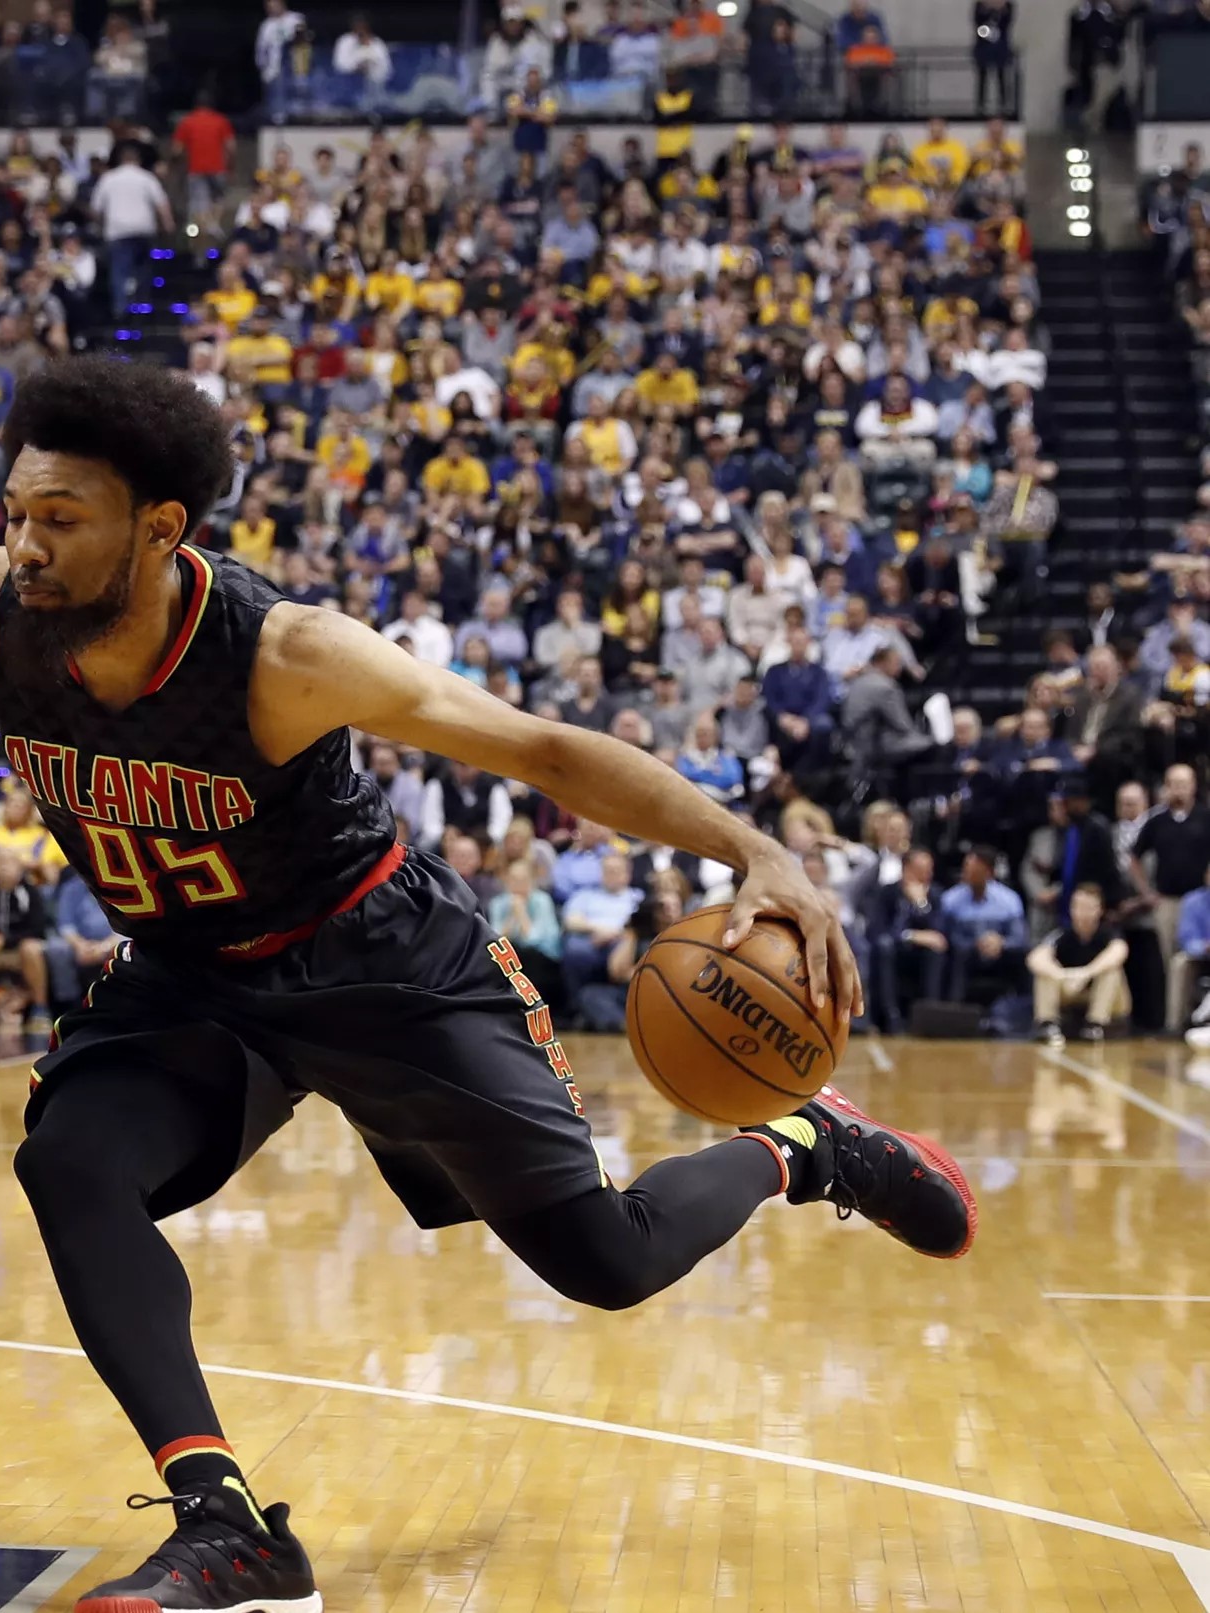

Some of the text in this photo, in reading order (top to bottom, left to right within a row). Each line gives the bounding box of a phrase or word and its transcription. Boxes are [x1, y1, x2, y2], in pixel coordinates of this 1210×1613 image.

[4, 735, 256, 831] ATLANTA
[77, 818, 247, 919] 95
[690, 958, 824, 1078] SPALDING
